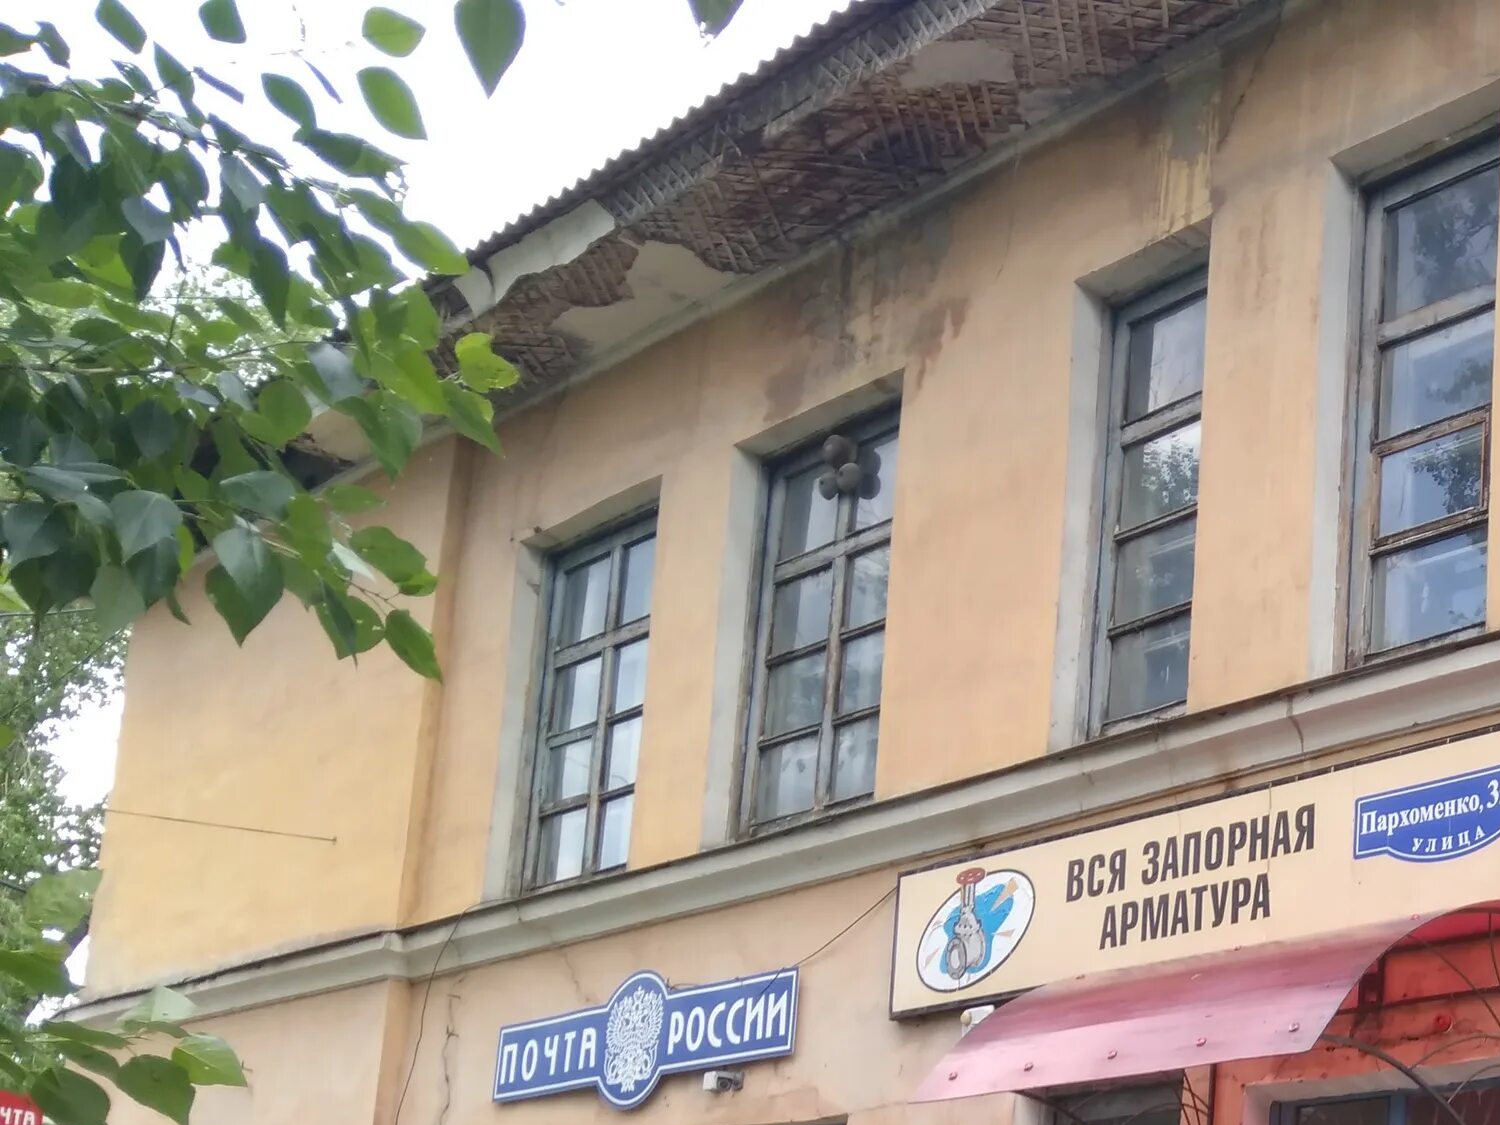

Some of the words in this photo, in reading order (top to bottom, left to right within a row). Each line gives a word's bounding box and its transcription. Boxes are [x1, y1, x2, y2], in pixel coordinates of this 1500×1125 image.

[1066, 848, 1127, 903] ВСЯ
[1141, 803, 1315, 885] ЗАПОРНАЯ
[1360, 794, 1484, 836] Пархоменко,
[1412, 825, 1486, 853] УЛИЦА
[1099, 872, 1271, 950] АРМАТУРА
[500, 1027, 598, 1085] ПОЧТА
[667, 990, 788, 1056] РОССИИ
